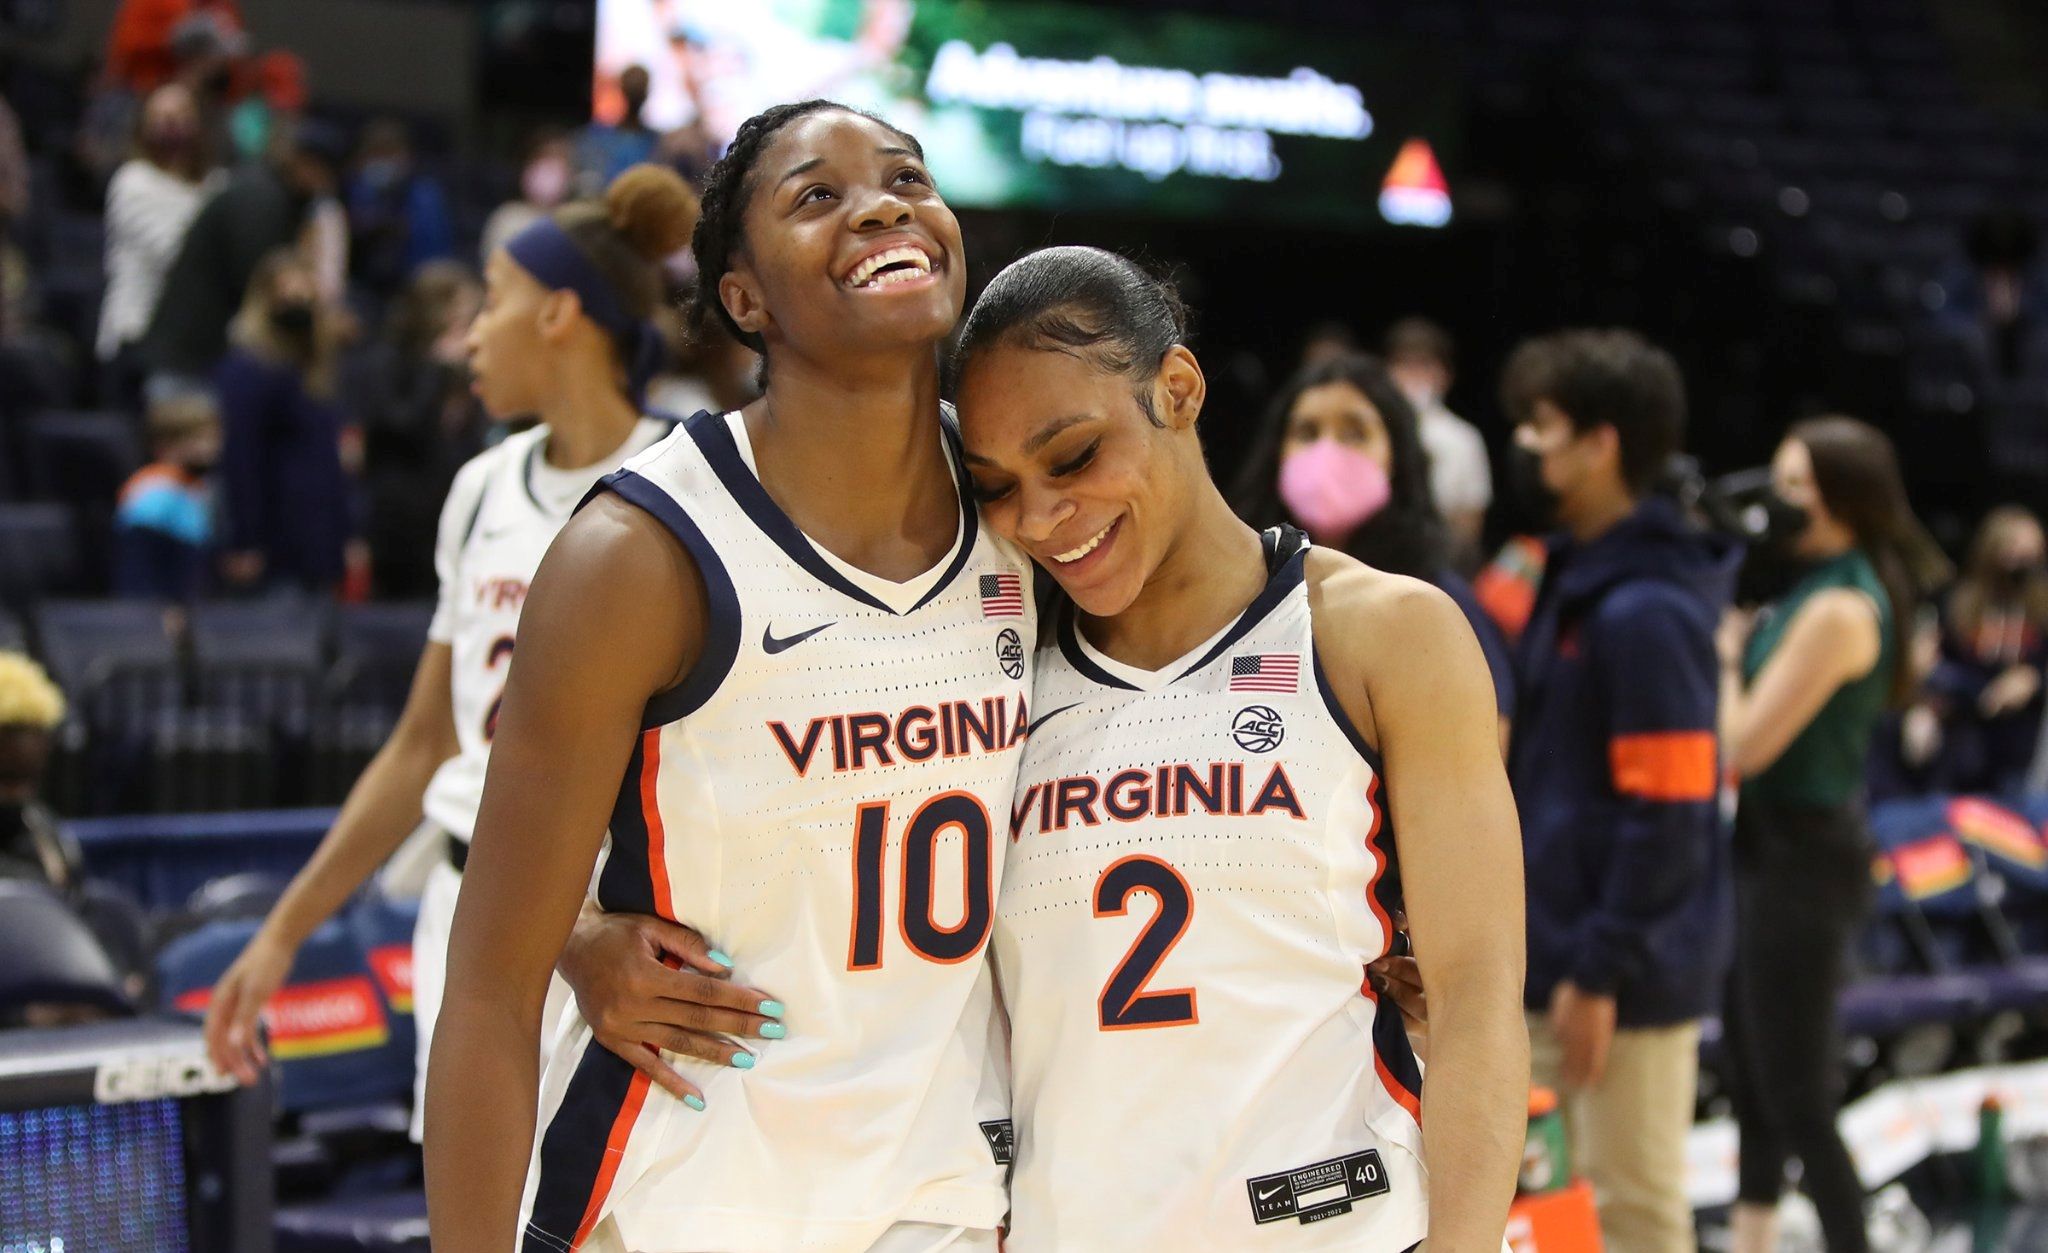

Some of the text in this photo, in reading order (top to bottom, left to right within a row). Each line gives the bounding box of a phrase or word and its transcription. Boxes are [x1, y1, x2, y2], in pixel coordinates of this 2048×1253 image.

[1000, 644, 1022, 658] ACC
[766, 690, 1028, 779] VIRGINIA
[1239, 719, 1283, 736] ACC
[1010, 761, 1308, 843] VIRGINIA
[847, 790, 993, 971] 10
[1093, 854, 1199, 1031] 2
[1292, 1164, 1342, 1182] ENGINEERED
[1355, 1164, 1378, 1184] 40
[1260, 1200, 1292, 1212] TEAM
